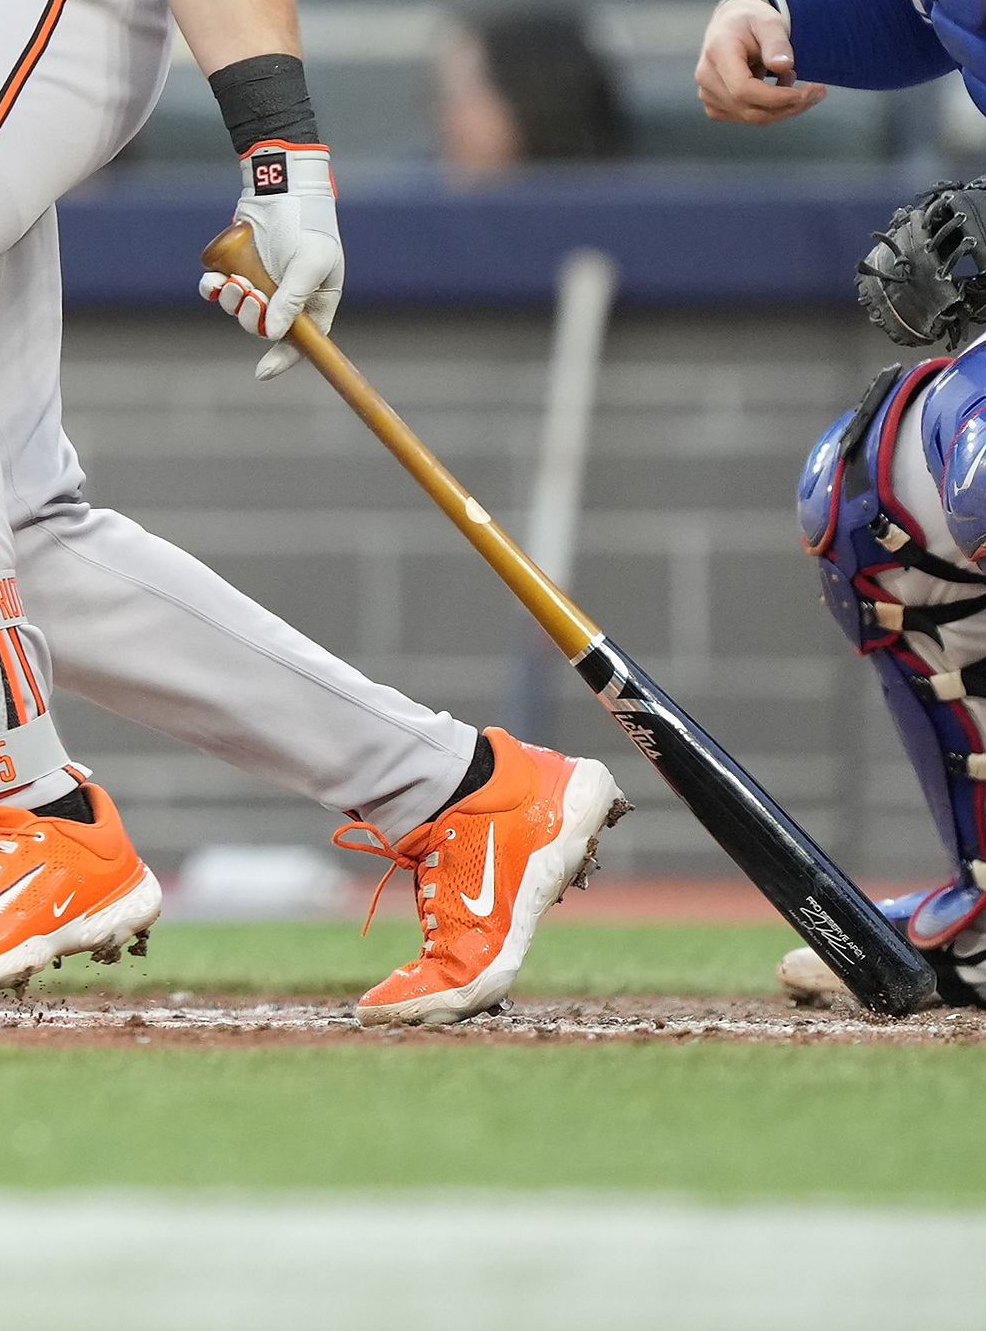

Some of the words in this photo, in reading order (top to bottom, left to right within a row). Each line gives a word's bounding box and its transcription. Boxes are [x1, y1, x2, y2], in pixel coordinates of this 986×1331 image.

[256, 162, 284, 187] 35
[805, 895, 823, 913] PRO
[820, 910, 851, 943] RESERVE
